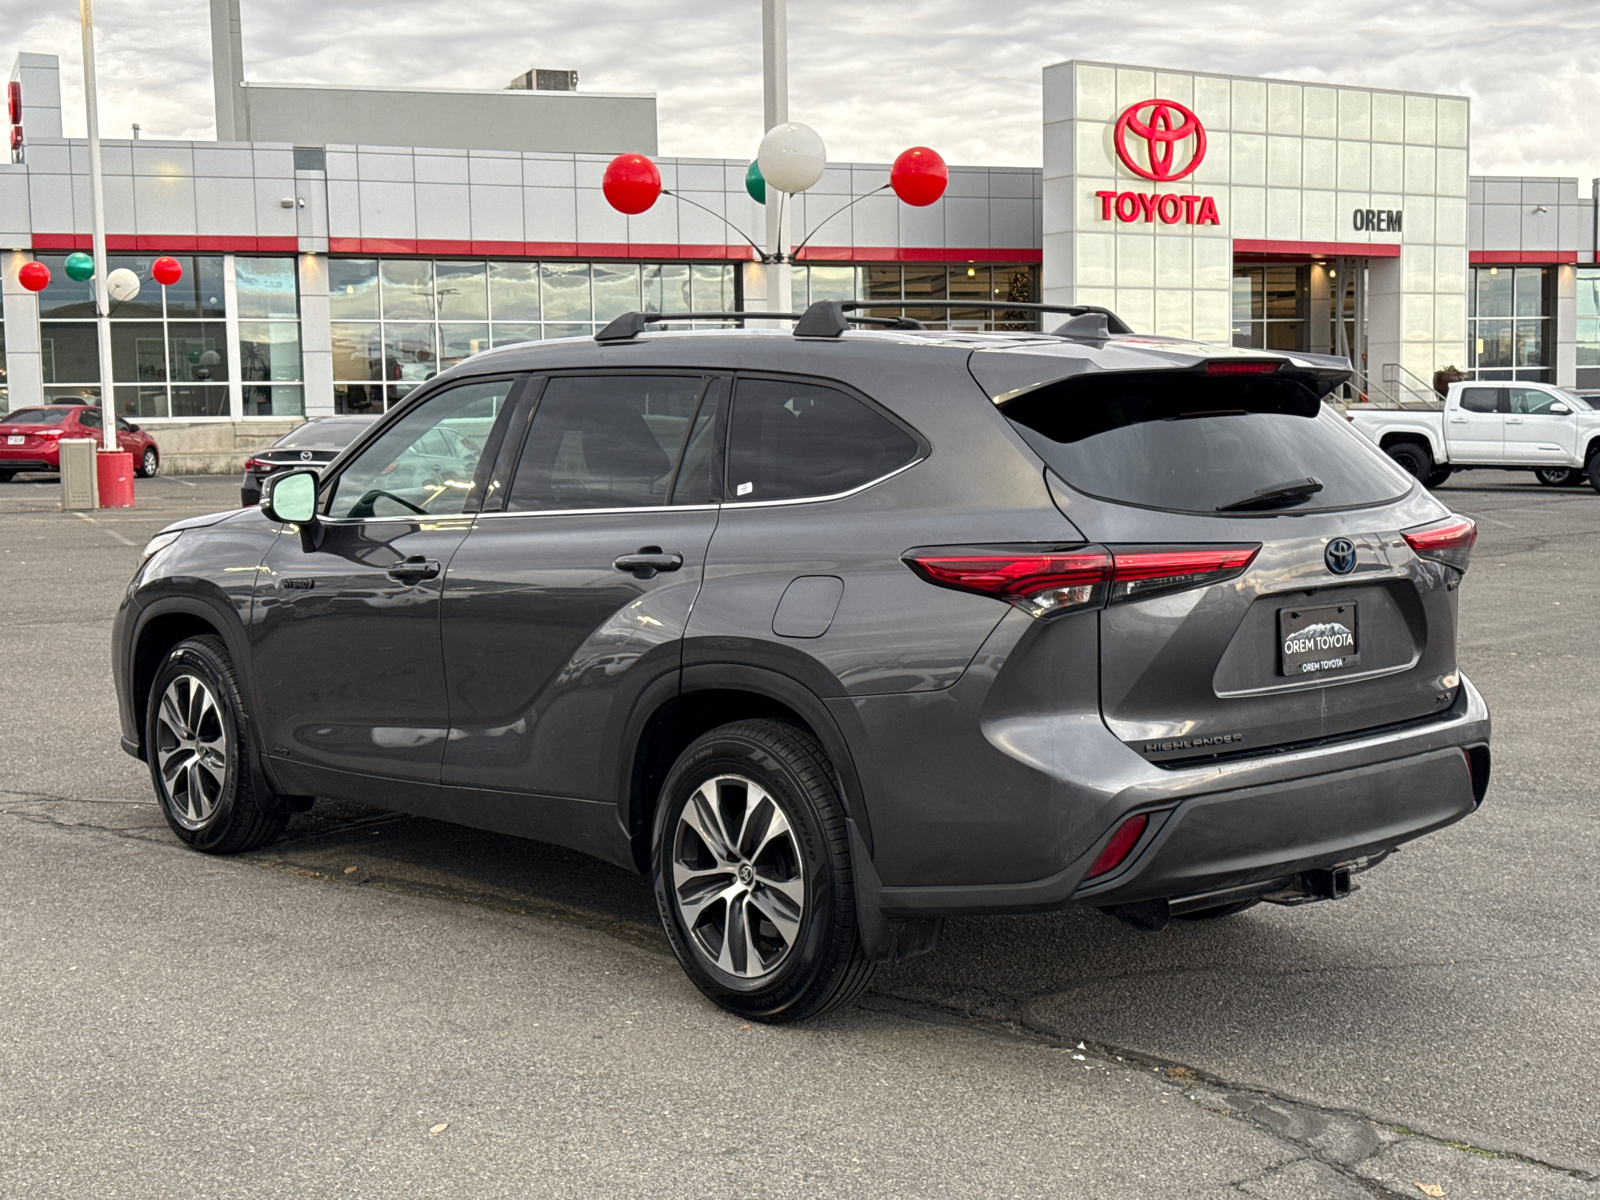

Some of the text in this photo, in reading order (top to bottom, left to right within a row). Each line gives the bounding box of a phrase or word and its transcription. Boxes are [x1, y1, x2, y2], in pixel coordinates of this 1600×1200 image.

[1095, 190, 1221, 226] TOYOTA
[1353, 208, 1403, 233] OREM
[1284, 633, 1354, 655] OREM TOYOTA
[1302, 658, 1344, 673] OREM TOYOTA
[1144, 733, 1242, 753] HIGHLANDER
